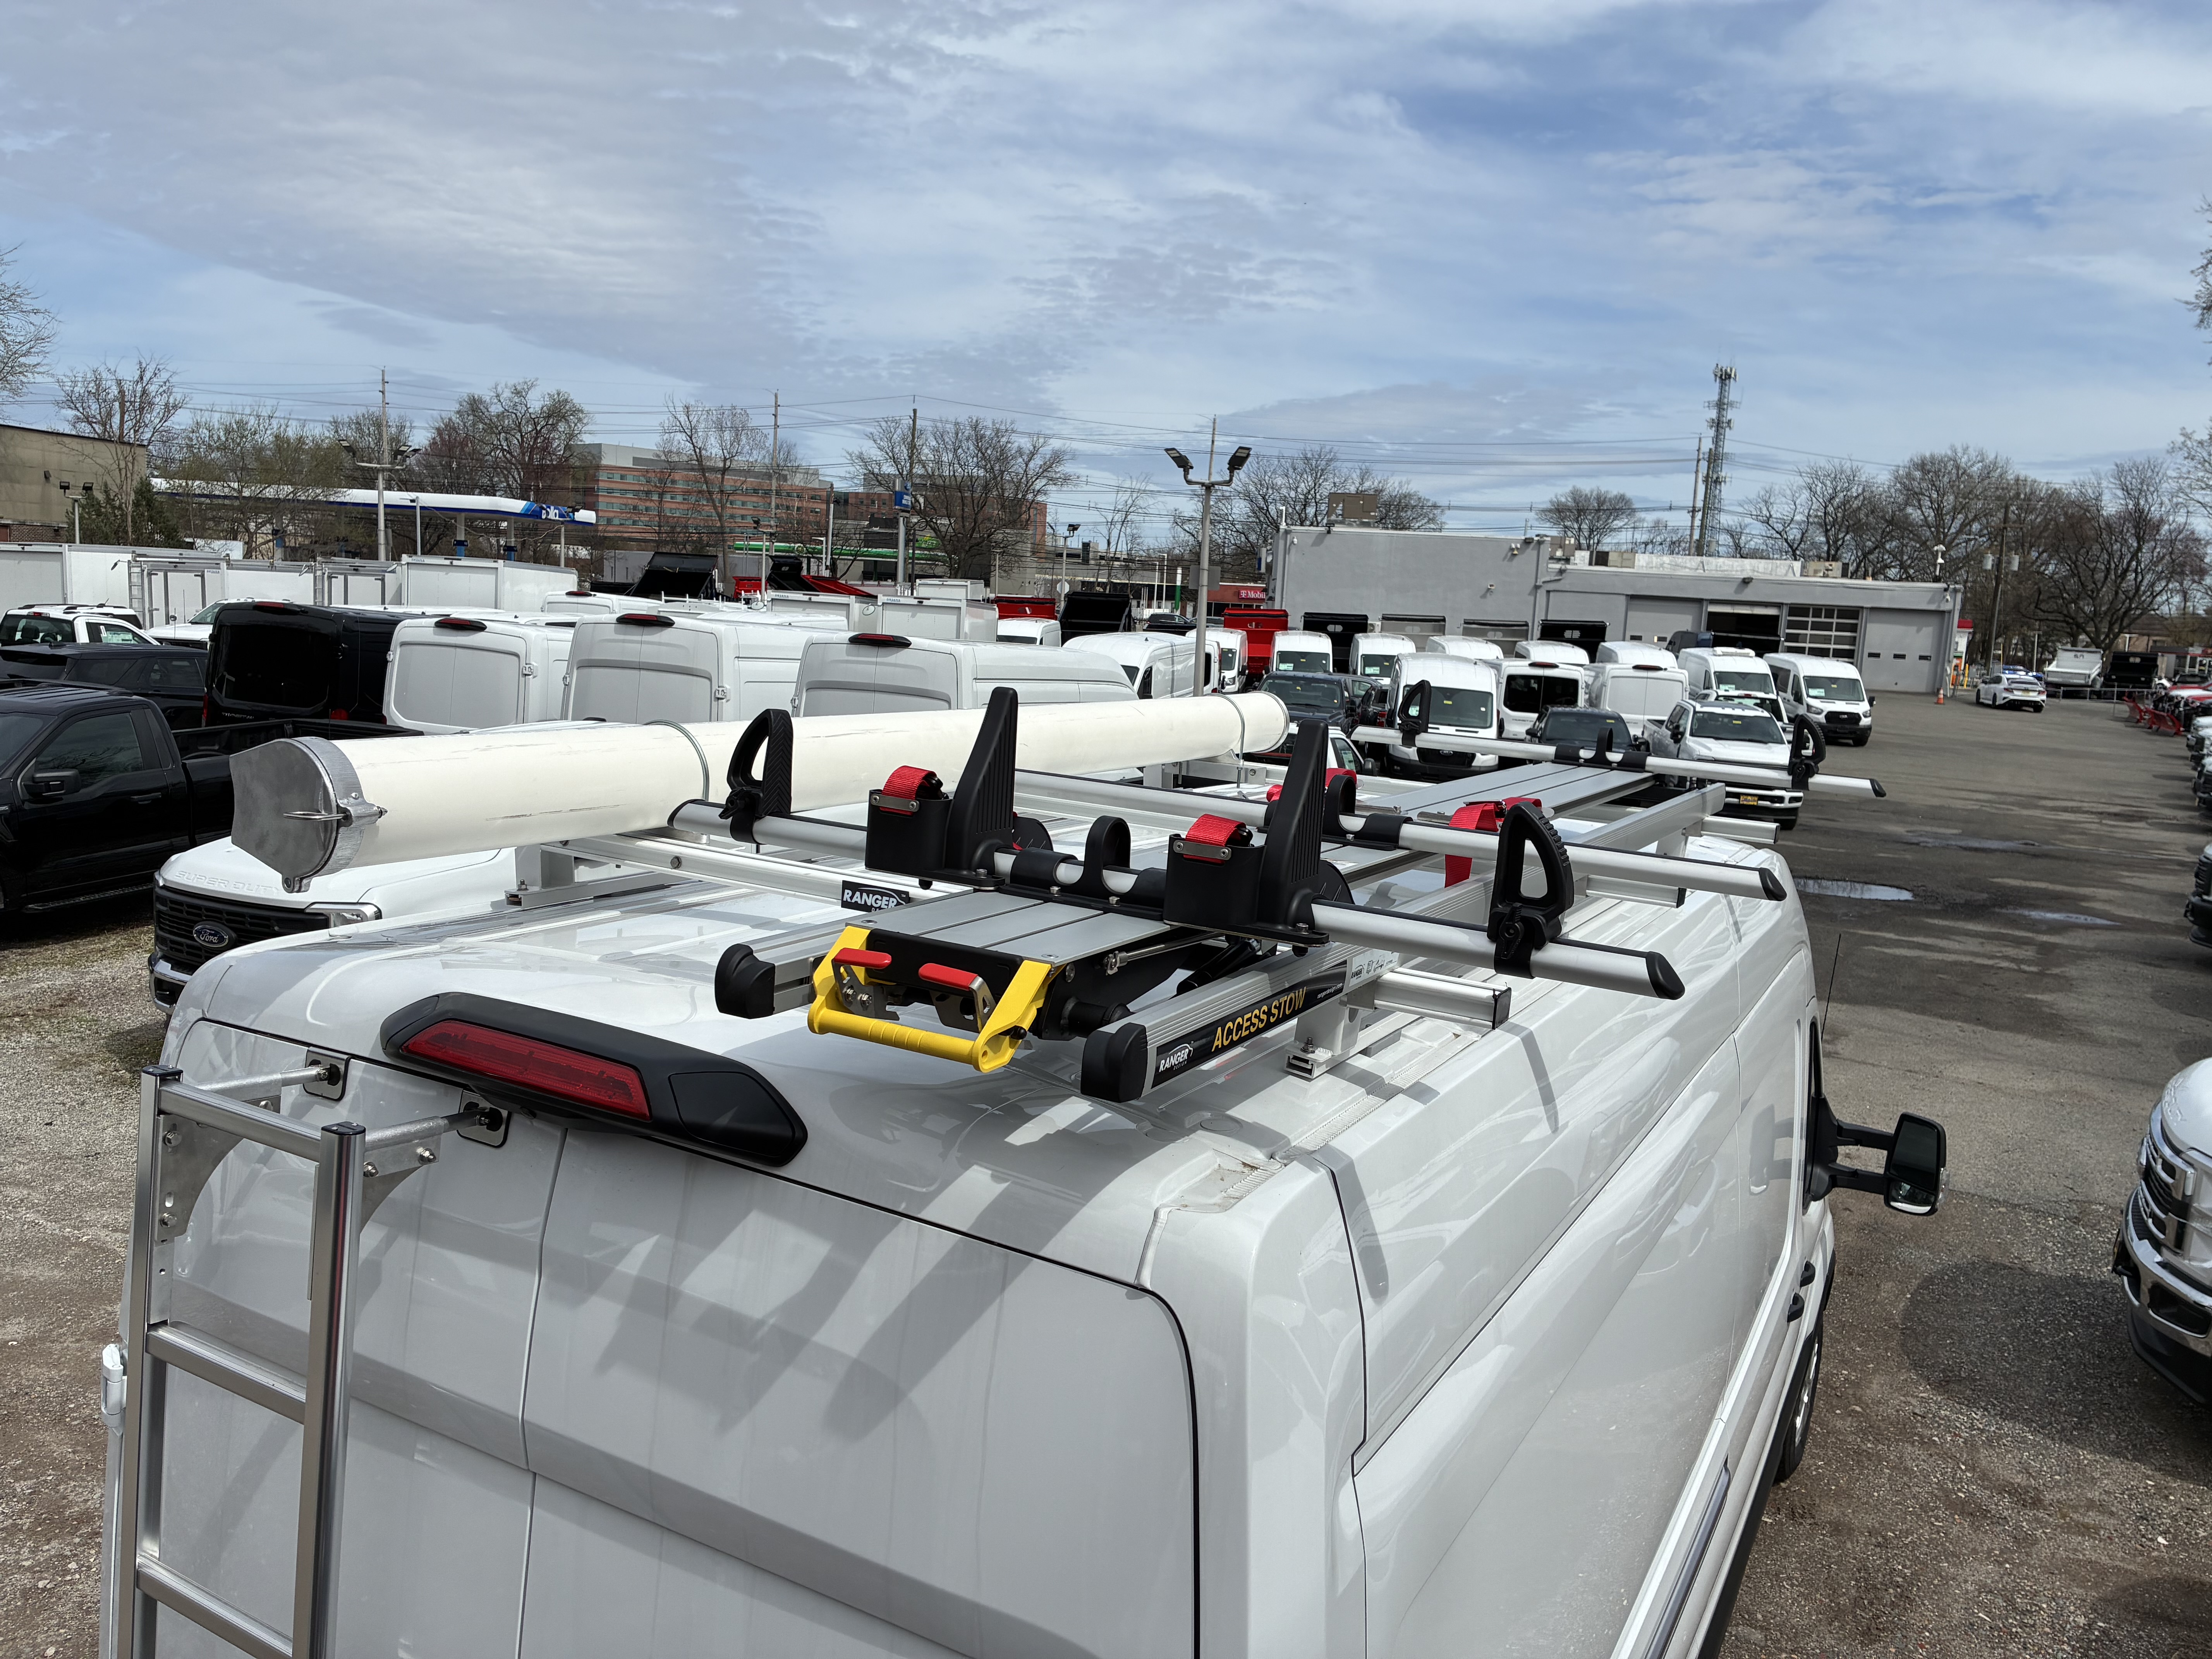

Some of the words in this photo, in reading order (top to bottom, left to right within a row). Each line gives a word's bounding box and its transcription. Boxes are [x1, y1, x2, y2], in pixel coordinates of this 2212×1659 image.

[175, 871, 230, 888] SUPER
[232, 881, 279, 895] DUTY
[843, 889, 897, 909] RANGER
[200, 929, 219, 943] Ford
[1211, 1005, 1268, 1052] ACCESS
[1270, 986, 1307, 1023] STOW
[1159, 1048, 1189, 1072] RANGER
